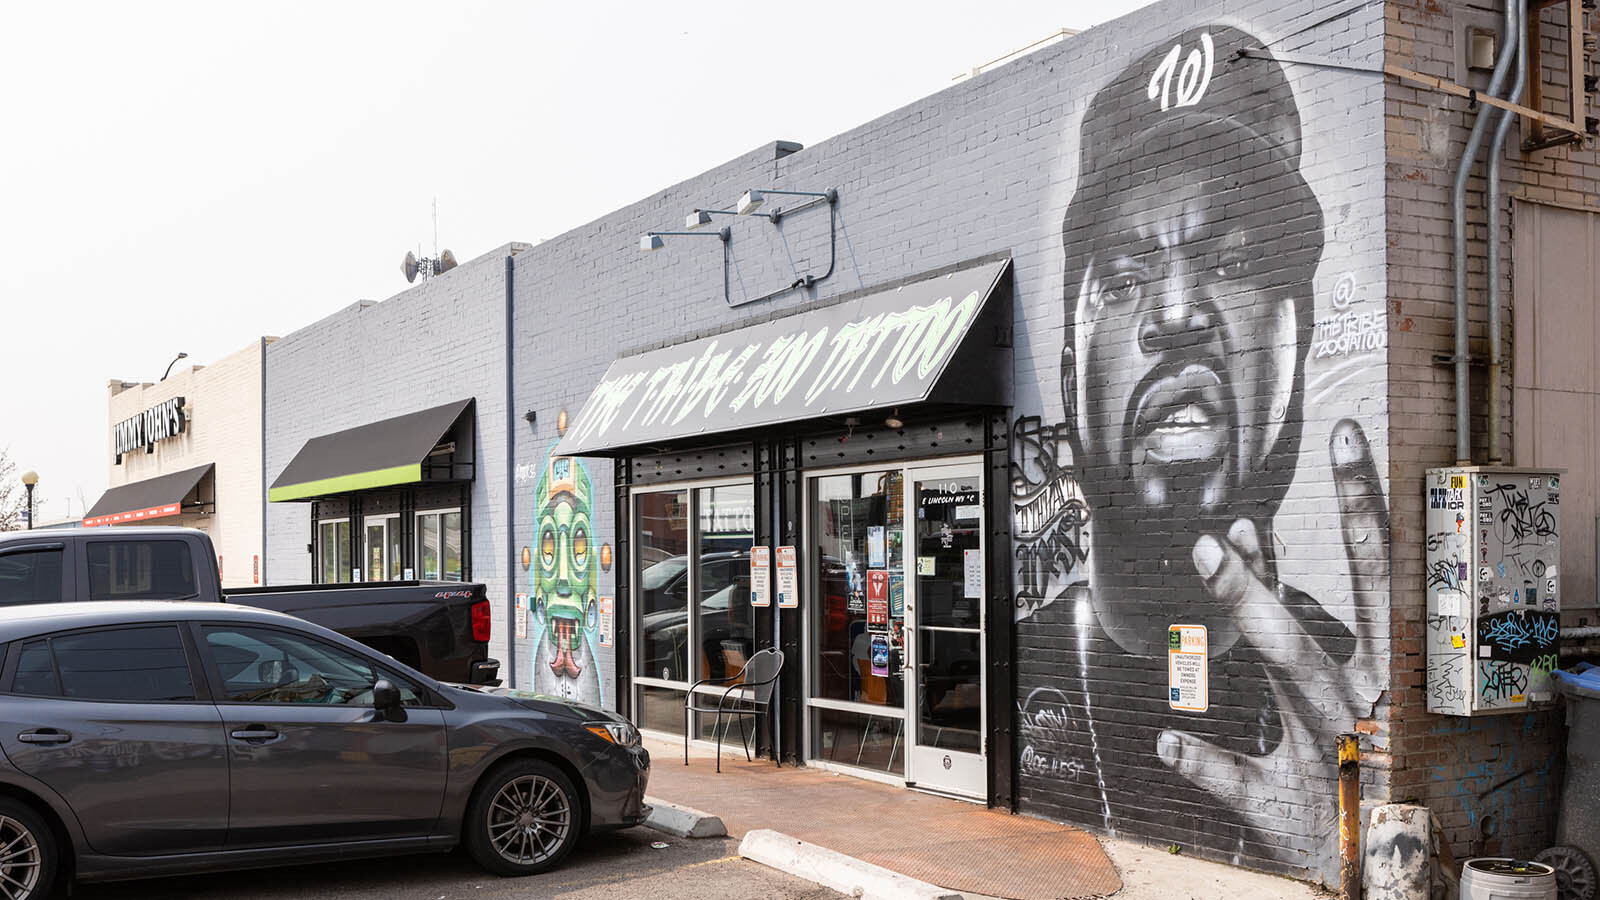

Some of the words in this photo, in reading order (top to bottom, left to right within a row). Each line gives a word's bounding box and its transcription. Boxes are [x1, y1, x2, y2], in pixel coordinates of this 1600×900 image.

[622, 340, 762, 432] TRIBE
[728, 326, 829, 413] ZOO
[804, 290, 979, 407] TATTOO
[112, 411, 145, 465] JIMMY
[144, 397, 184, 455] JOHN'S
[938, 482, 958, 495] 110
[1450, 476, 1464, 489] FUN
[927, 496, 954, 505] LINCOLN
